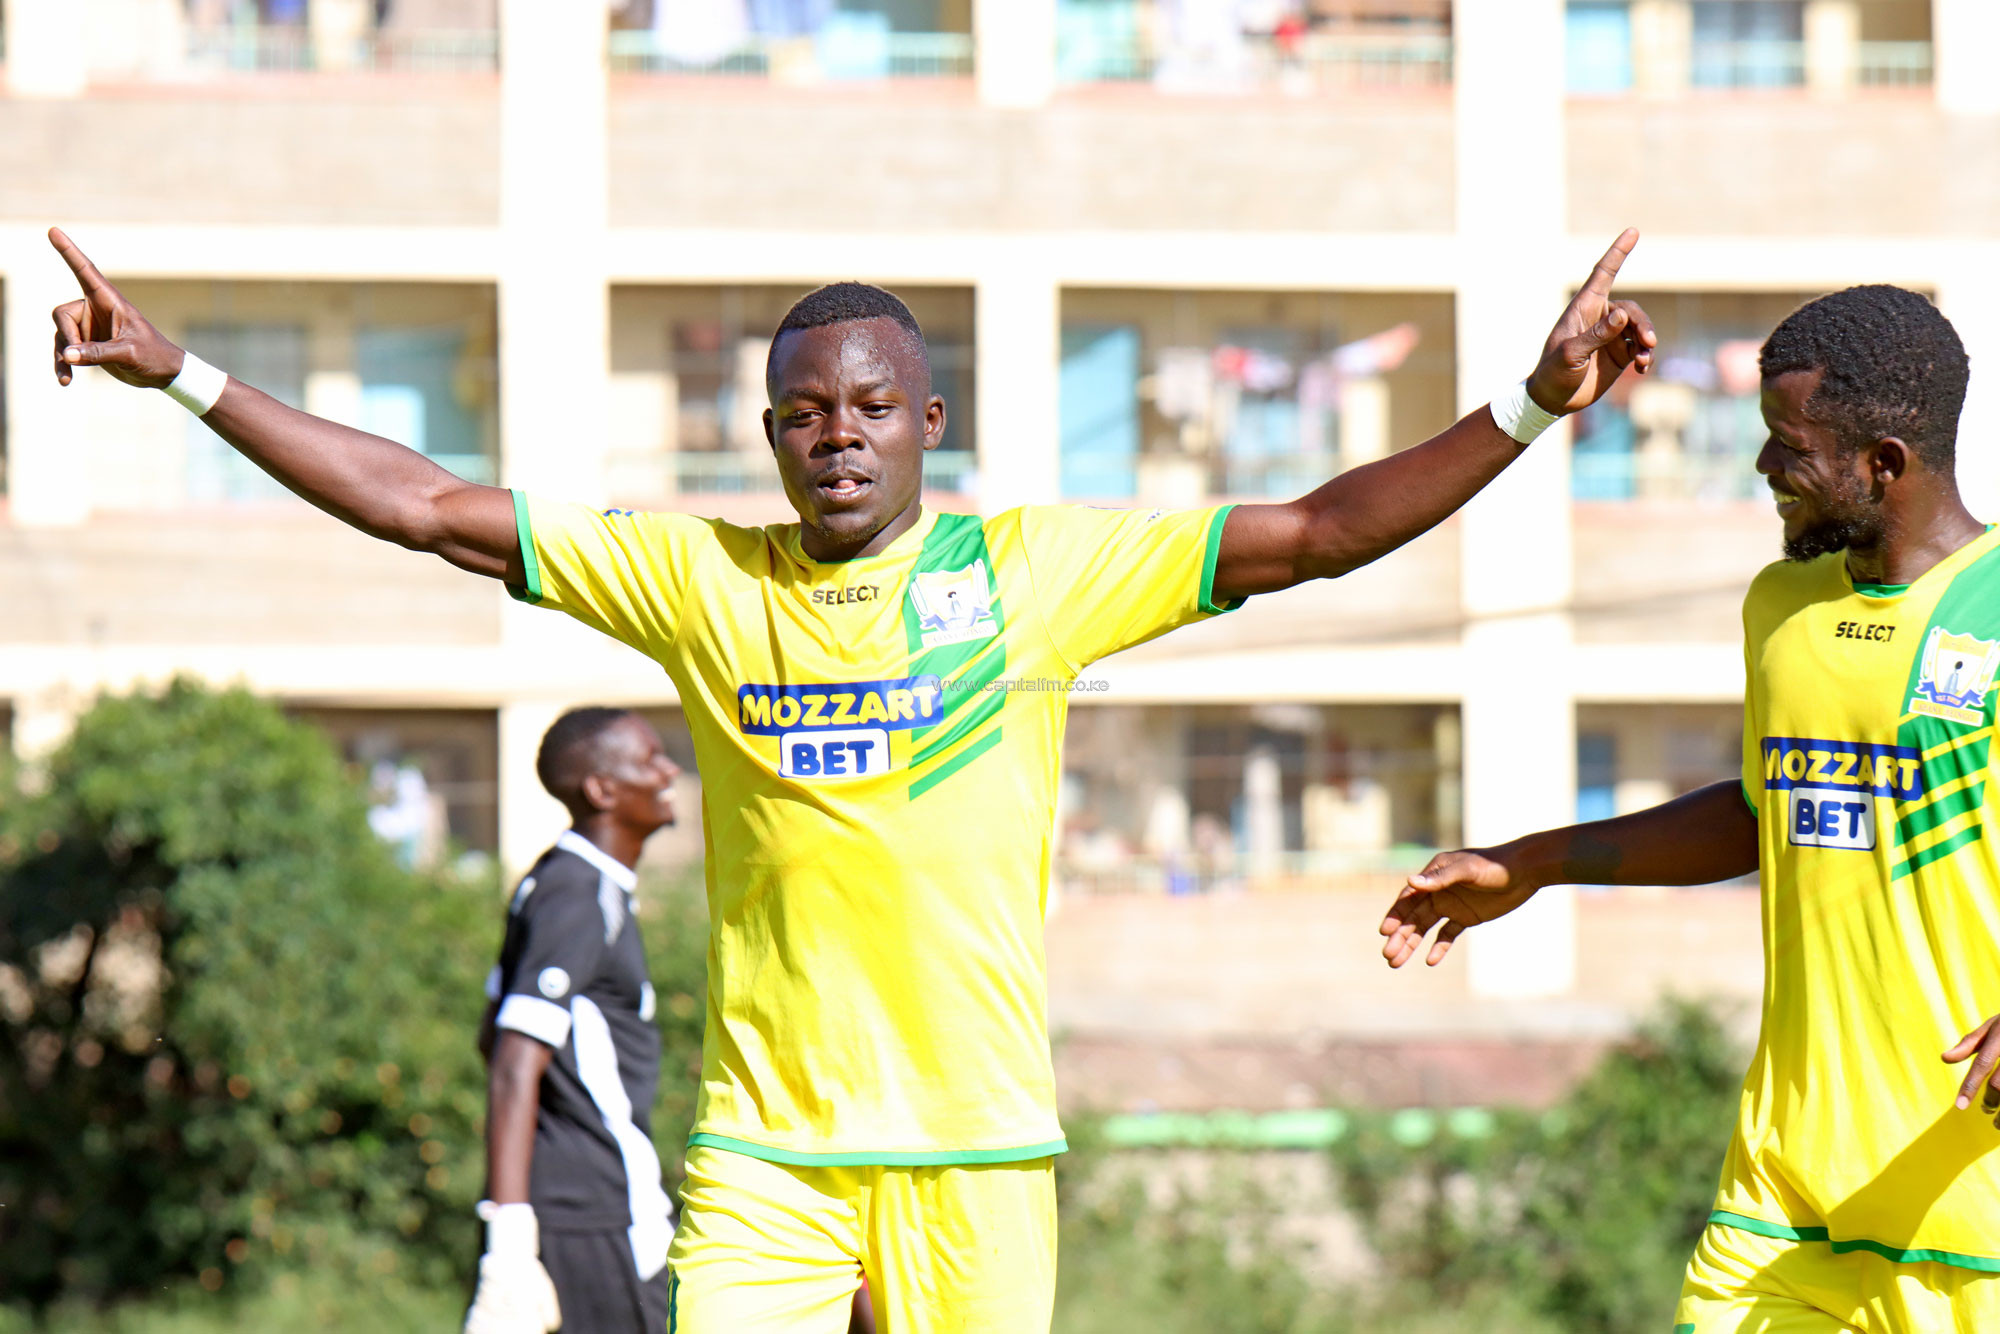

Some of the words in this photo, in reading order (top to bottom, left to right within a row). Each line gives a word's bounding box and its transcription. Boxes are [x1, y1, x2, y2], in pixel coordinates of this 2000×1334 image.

[812, 585, 880, 605] SELECT
[1835, 622, 1895, 642] SELECT
[742, 686, 936, 727] MOZZART
[791, 740, 875, 775] BET
[1764, 748, 1921, 791] MOZZART
[1795, 798, 1867, 839] BET
